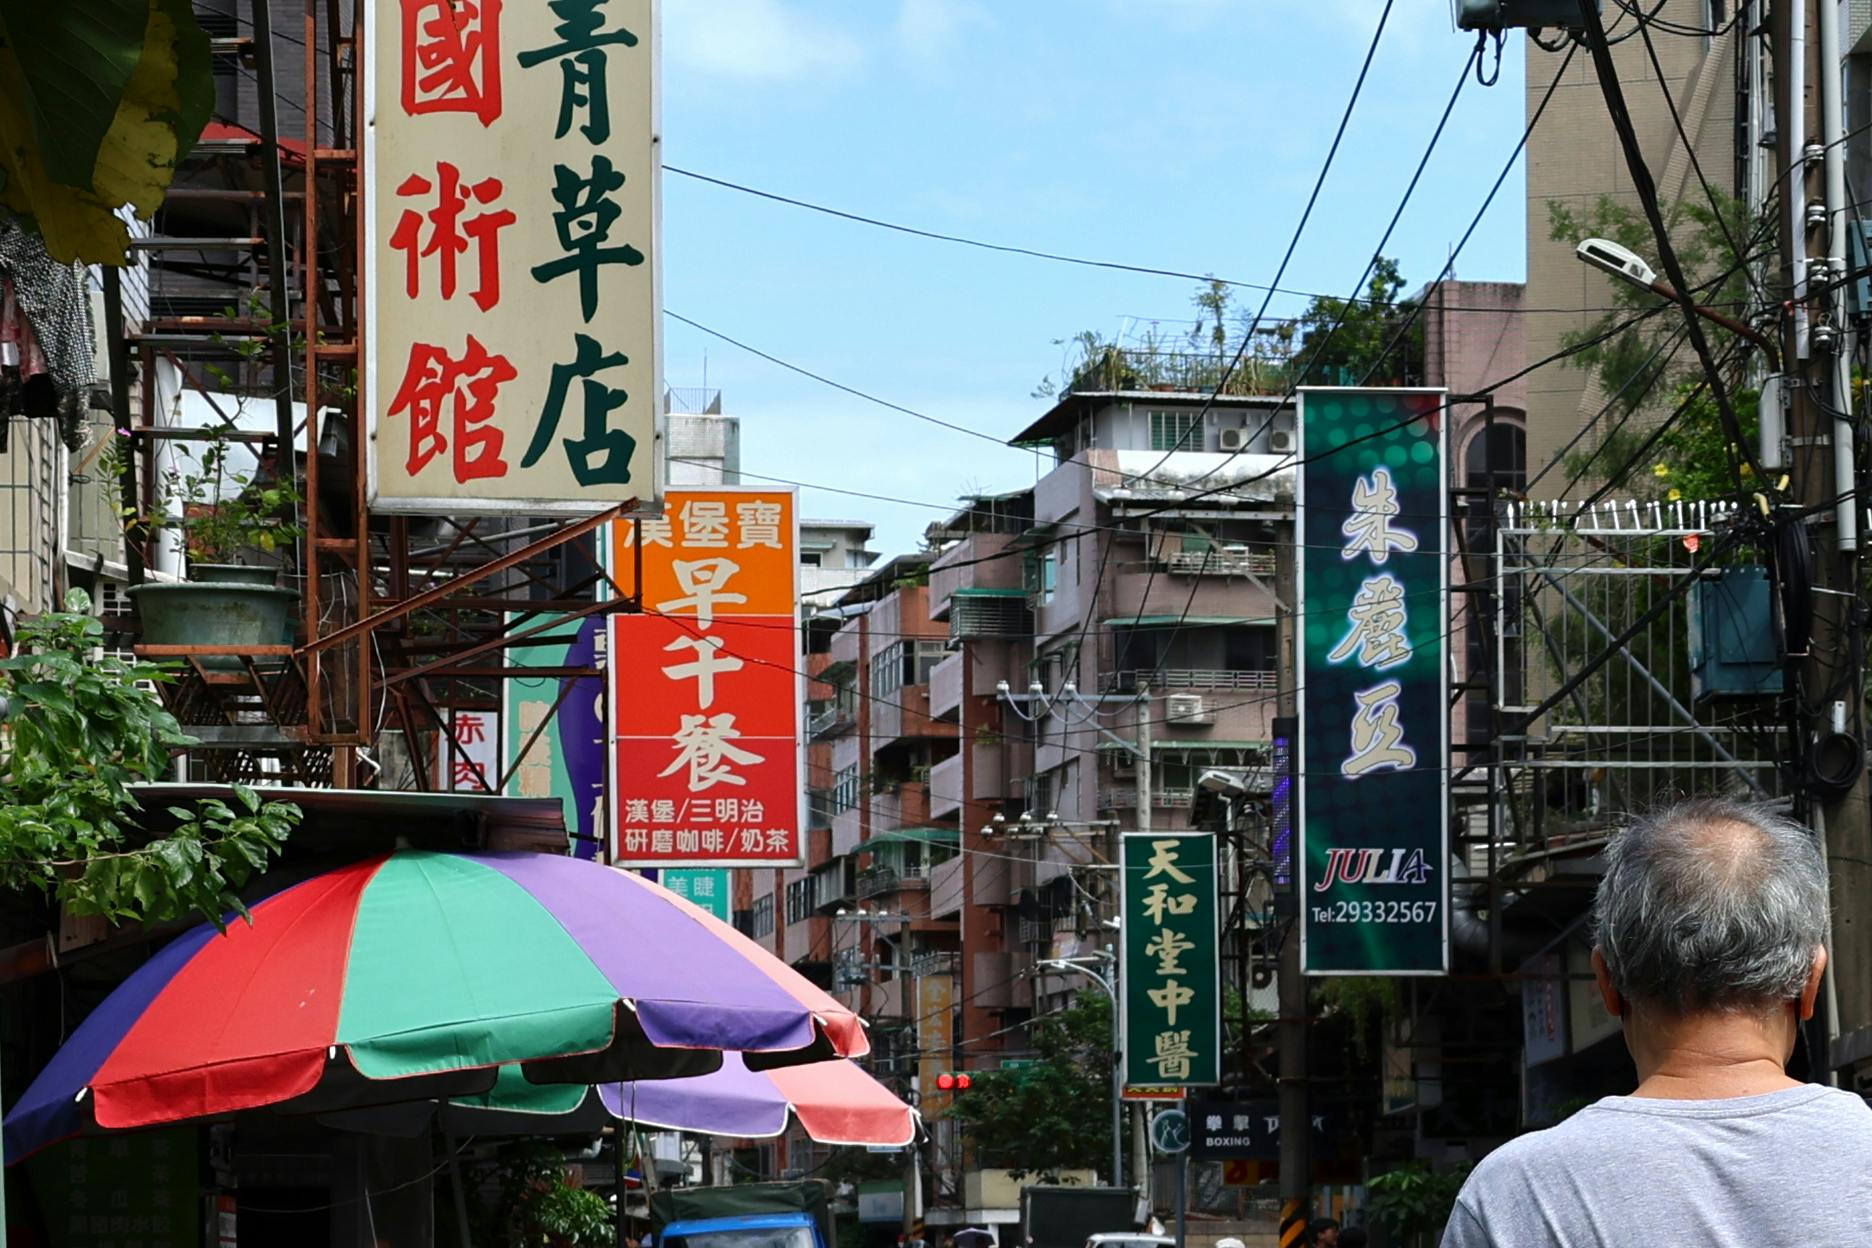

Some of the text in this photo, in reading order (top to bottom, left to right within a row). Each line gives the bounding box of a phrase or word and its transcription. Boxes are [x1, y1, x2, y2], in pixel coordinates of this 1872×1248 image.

[387, 0, 518, 485] 國術館
[517, 0, 645, 488] 青草店
[656, 557, 766, 793] 早午餐
[625, 798, 765, 824] 漢堡/三明治
[625, 827, 789, 854] 研磨咖啡/奶茶
[1313, 848, 1434, 892] JULIA
[1312, 901, 1437, 924] Tel:29332567
[1141, 839, 1199, 1081] 天和堂中醫
[1205, 1136, 1250, 1147] BOXING
